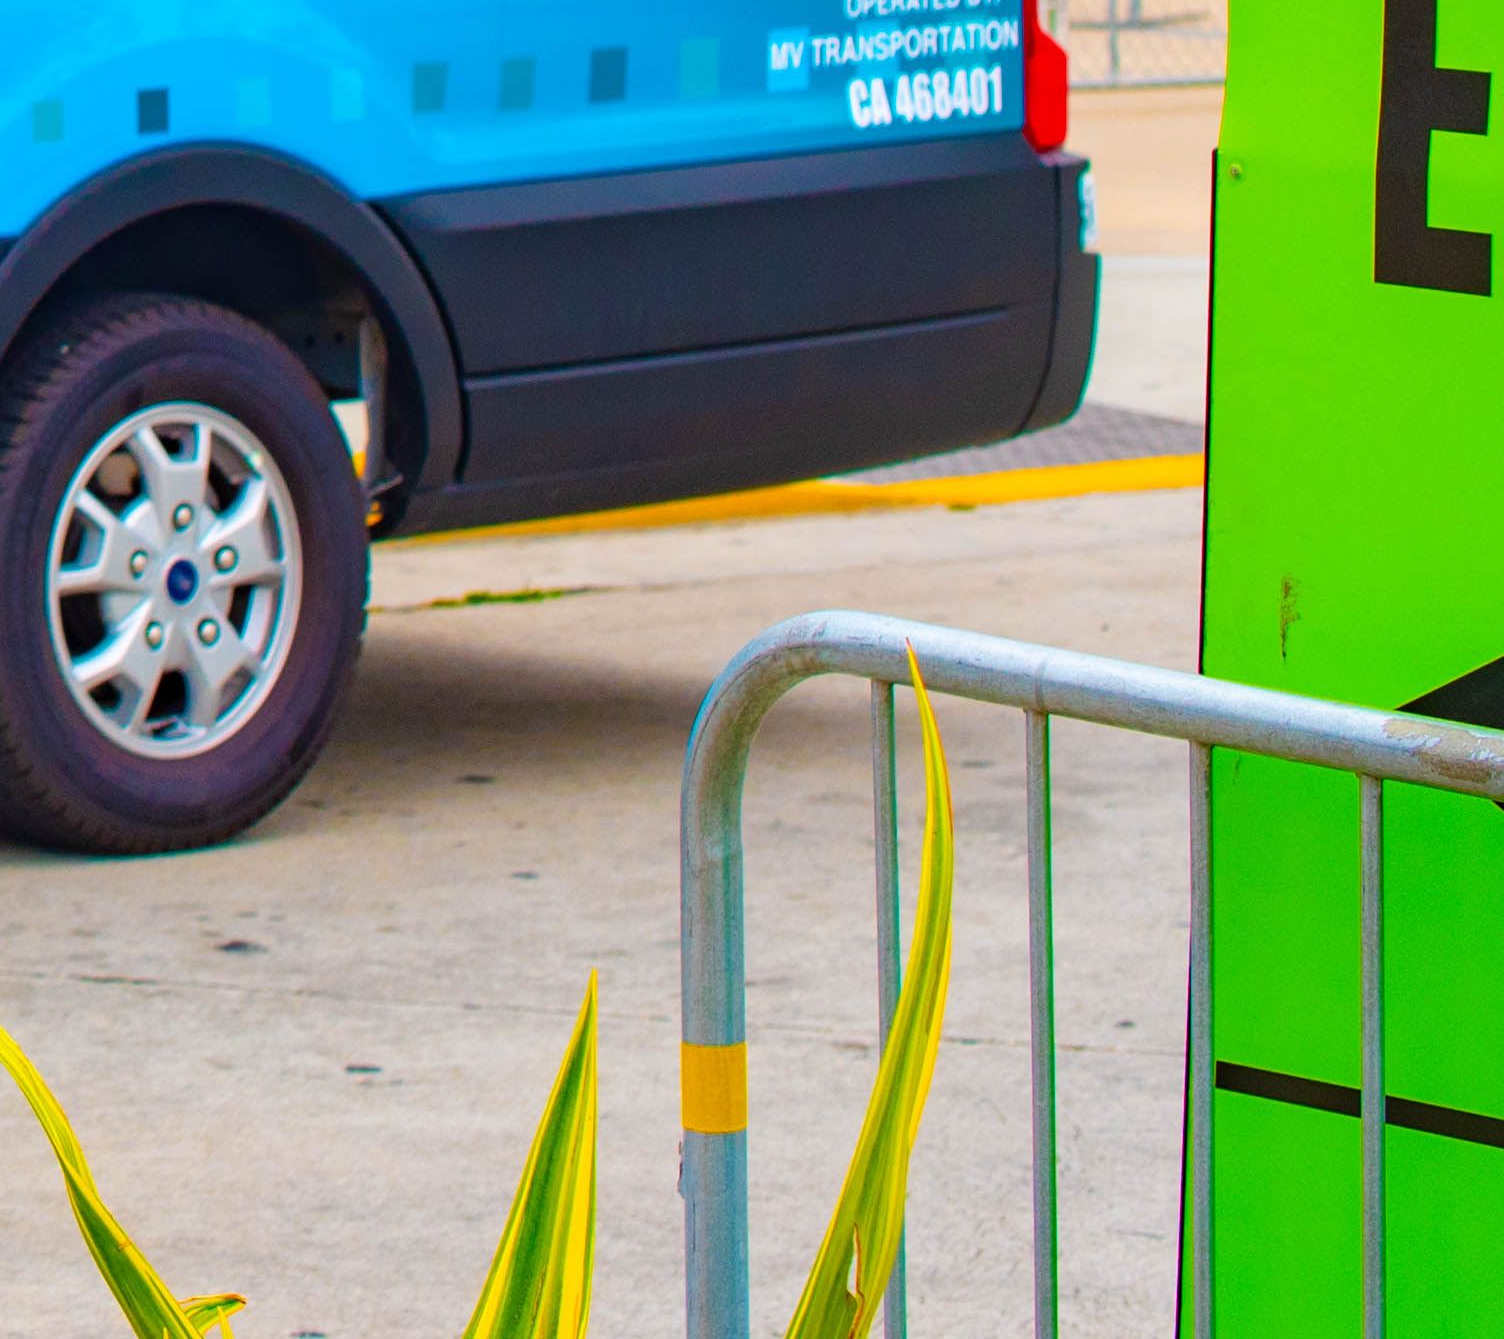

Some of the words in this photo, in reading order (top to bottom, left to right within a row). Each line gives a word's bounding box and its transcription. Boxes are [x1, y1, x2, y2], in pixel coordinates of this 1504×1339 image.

[770, 41, 804, 71] MV
[811, 20, 1019, 68] TRANSPORTATION
[848, 77, 893, 128] CA
[894, 66, 1003, 122] 468401
